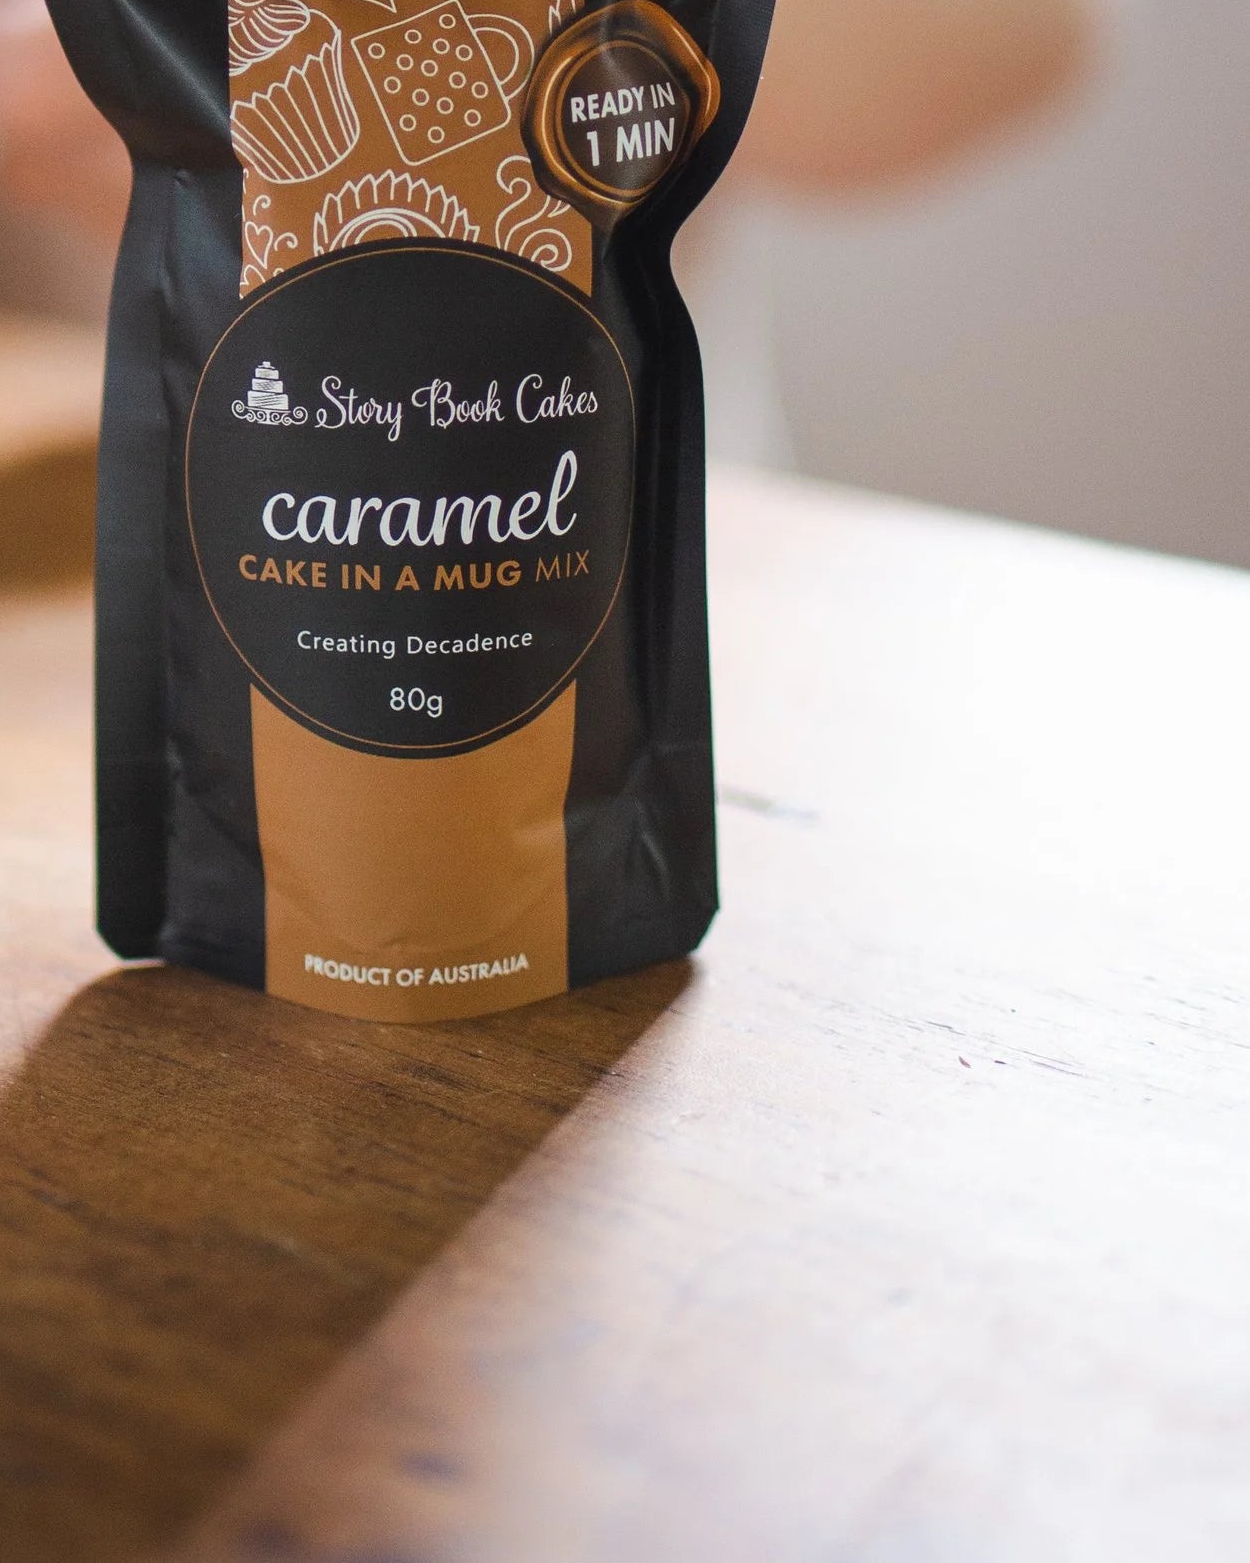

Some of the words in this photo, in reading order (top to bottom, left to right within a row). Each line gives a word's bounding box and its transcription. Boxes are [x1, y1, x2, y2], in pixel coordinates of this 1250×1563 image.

[570, 85, 644, 123] READY
[650, 82, 676, 109] IN
[586, 130, 600, 167] 1
[615, 117, 675, 163] MIN
[314, 375, 403, 442] Story
[411, 378, 505, 429] Book
[516, 373, 599, 424] Cakes
[262, 450, 578, 546] caramel
[238, 554, 327, 588] CAKE
[341, 564, 382, 590] IN
[394, 565, 421, 591] A
[433, 559, 522, 591] MUG
[534, 549, 591, 583] MIX
[297, 630, 396, 659] Creating
[407, 631, 534, 654] Decadence
[389, 687, 444, 717] 80g
[304, 954, 390, 985] PRODUCT
[396, 968, 424, 987] OF
[428, 953, 529, 985] AUSTRALIA
